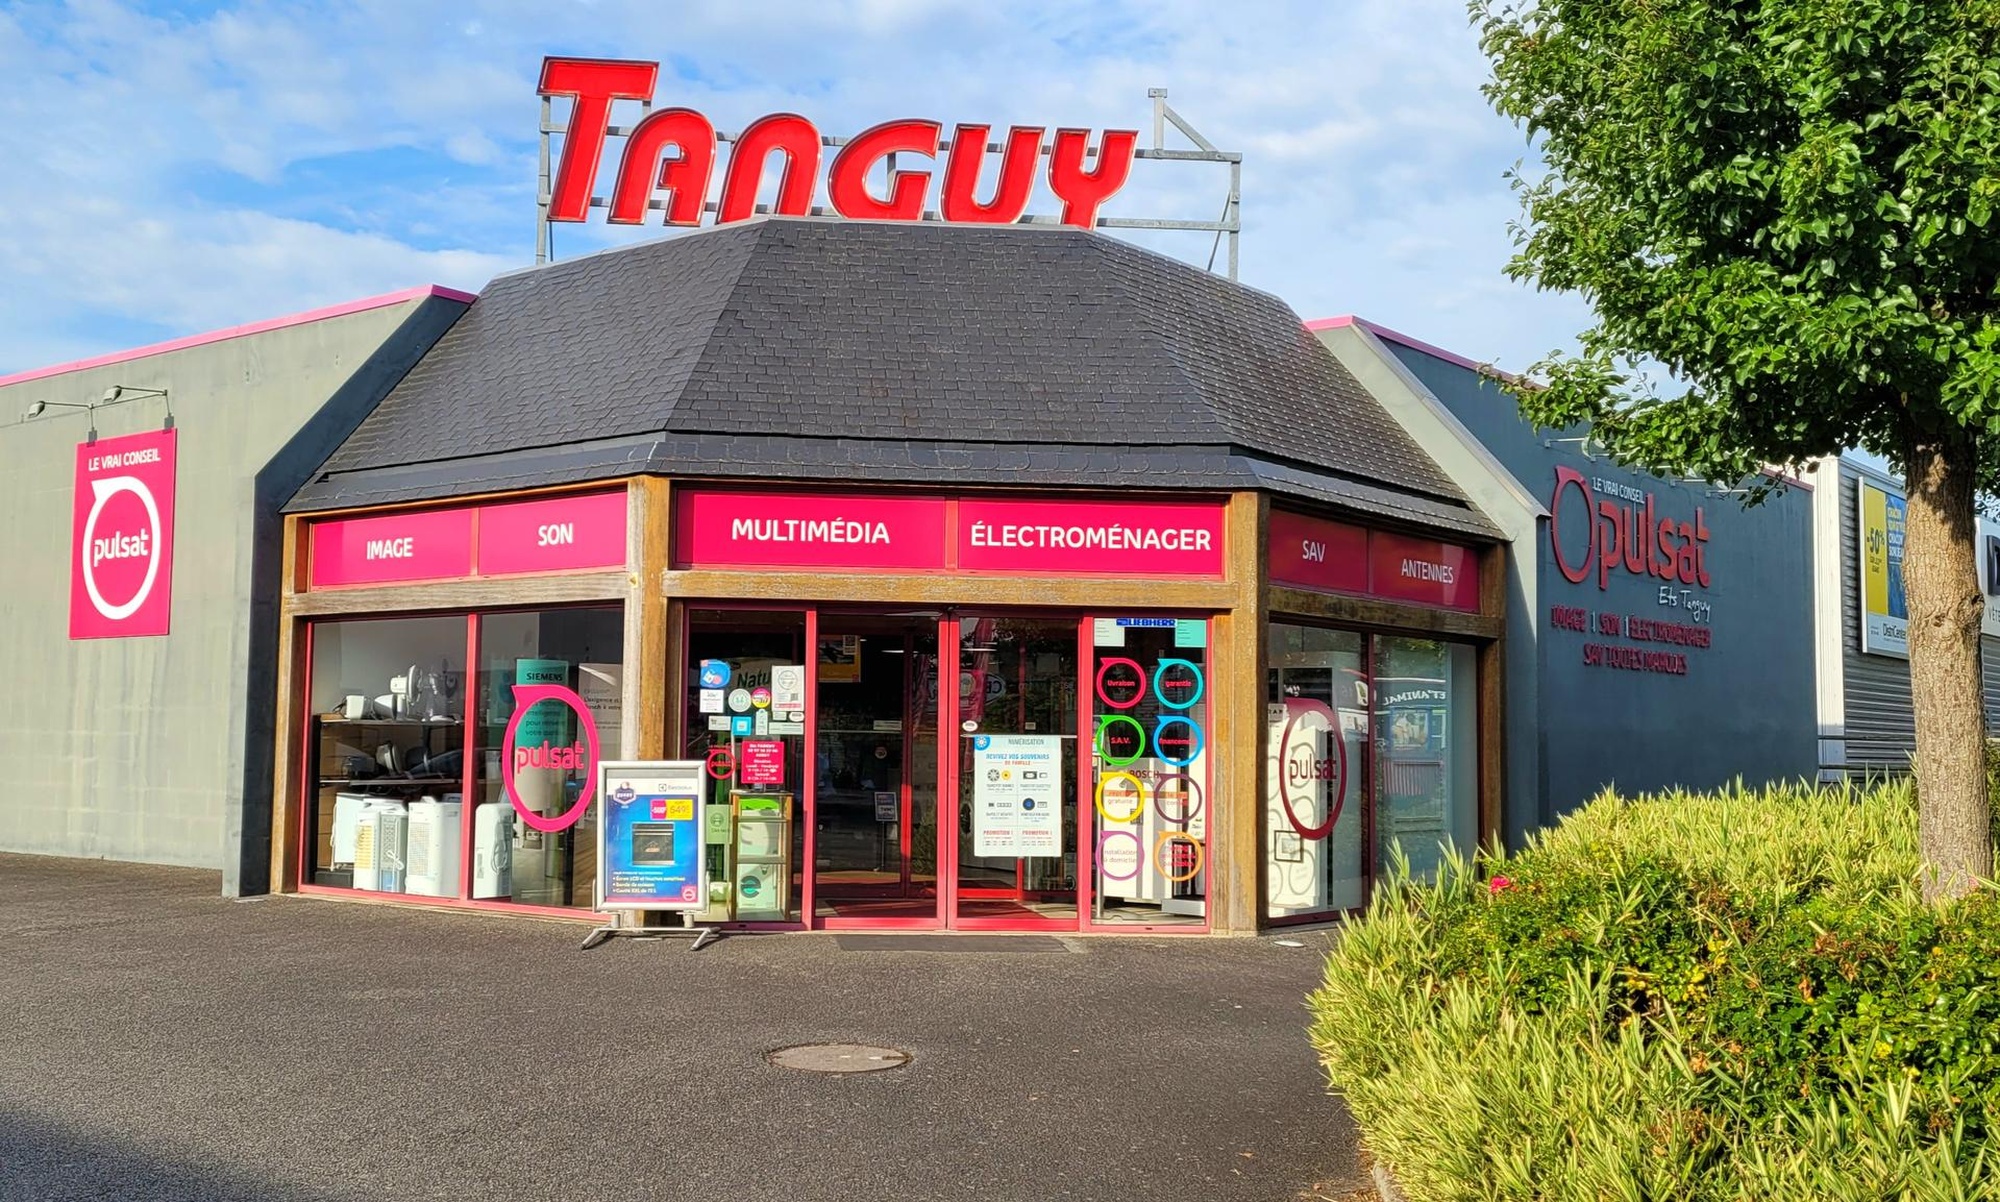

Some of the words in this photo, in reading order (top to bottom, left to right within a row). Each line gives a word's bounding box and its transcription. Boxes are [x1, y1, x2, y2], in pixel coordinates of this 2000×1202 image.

[536, 56, 1140, 229] TANGUY
[88, 457, 99, 471] LE
[101, 454, 122, 469] VRAI
[123, 448, 161, 466] CONSEIL
[1592, 477, 1602, 492] LE
[1603, 480, 1619, 495] VRAI
[1619, 484, 1645, 504] CONSEIL
[538, 522, 573, 546] SON
[731, 516, 890, 544] MULTIMÉDIA
[970, 520, 1212, 551] ÉLECTROMÉNAGER
[1599, 493, 1710, 590] pulsat
[94, 528, 149, 567] pulsat
[366, 537, 413, 560] IMAGE
[1302, 540, 1326, 562] SAV
[1401, 559, 1454, 584] ANTENNES
[1659, 586, 1677, 606] Ets
[1680, 589, 1711, 623] Tanguy
[1552, 605, 1586, 631] IMAGE
[1600, 612, 1621, 636] SON
[1607, 645, 1643, 669] TOUTES
[526, 672, 563, 681] SIEMENS
[1107, 679, 1135, 687] livraison
[1165, 680, 1192, 688] garantie
[516, 740, 585, 774] pulsat
[1289, 753, 1337, 786] pulsat
